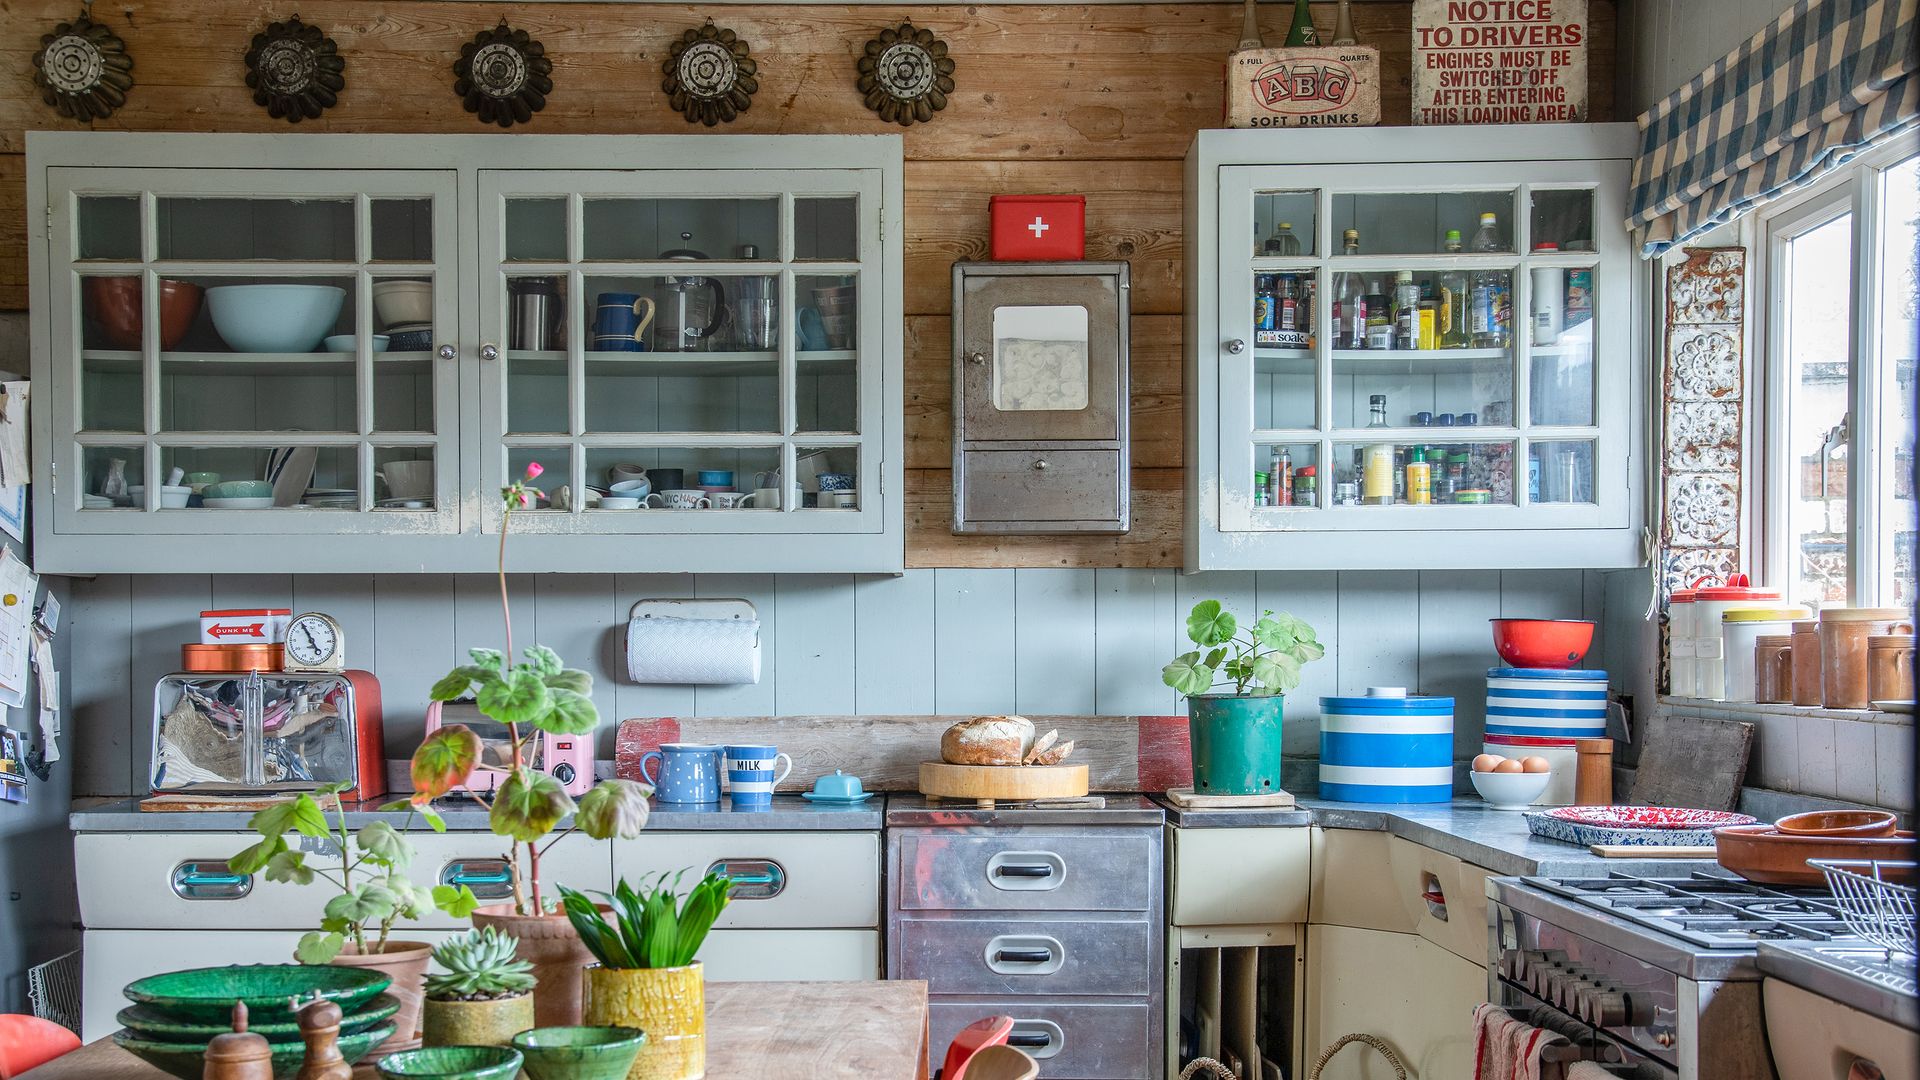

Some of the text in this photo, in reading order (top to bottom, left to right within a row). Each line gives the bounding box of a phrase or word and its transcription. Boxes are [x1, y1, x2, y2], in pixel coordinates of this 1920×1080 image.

[1449, 0, 1551, 21] NOTICE
[1417, 24, 1582, 47] TO DRIVERS
[1340, 54, 1369, 62] QUARTS
[1427, 50, 1571, 69] ENGINES MUST BE
[1440, 69, 1558, 87] SWITCHED OFF
[1267, 76, 1345, 101] ABC
[1433, 87, 1565, 105] AFTER ENTERING
[1250, 113, 1359, 127] SOFT DRINKS
[1421, 104, 1576, 124] THIS LOADING AREA
[1278, 333, 1304, 343] soak
[737, 760, 760, 771] MILK
